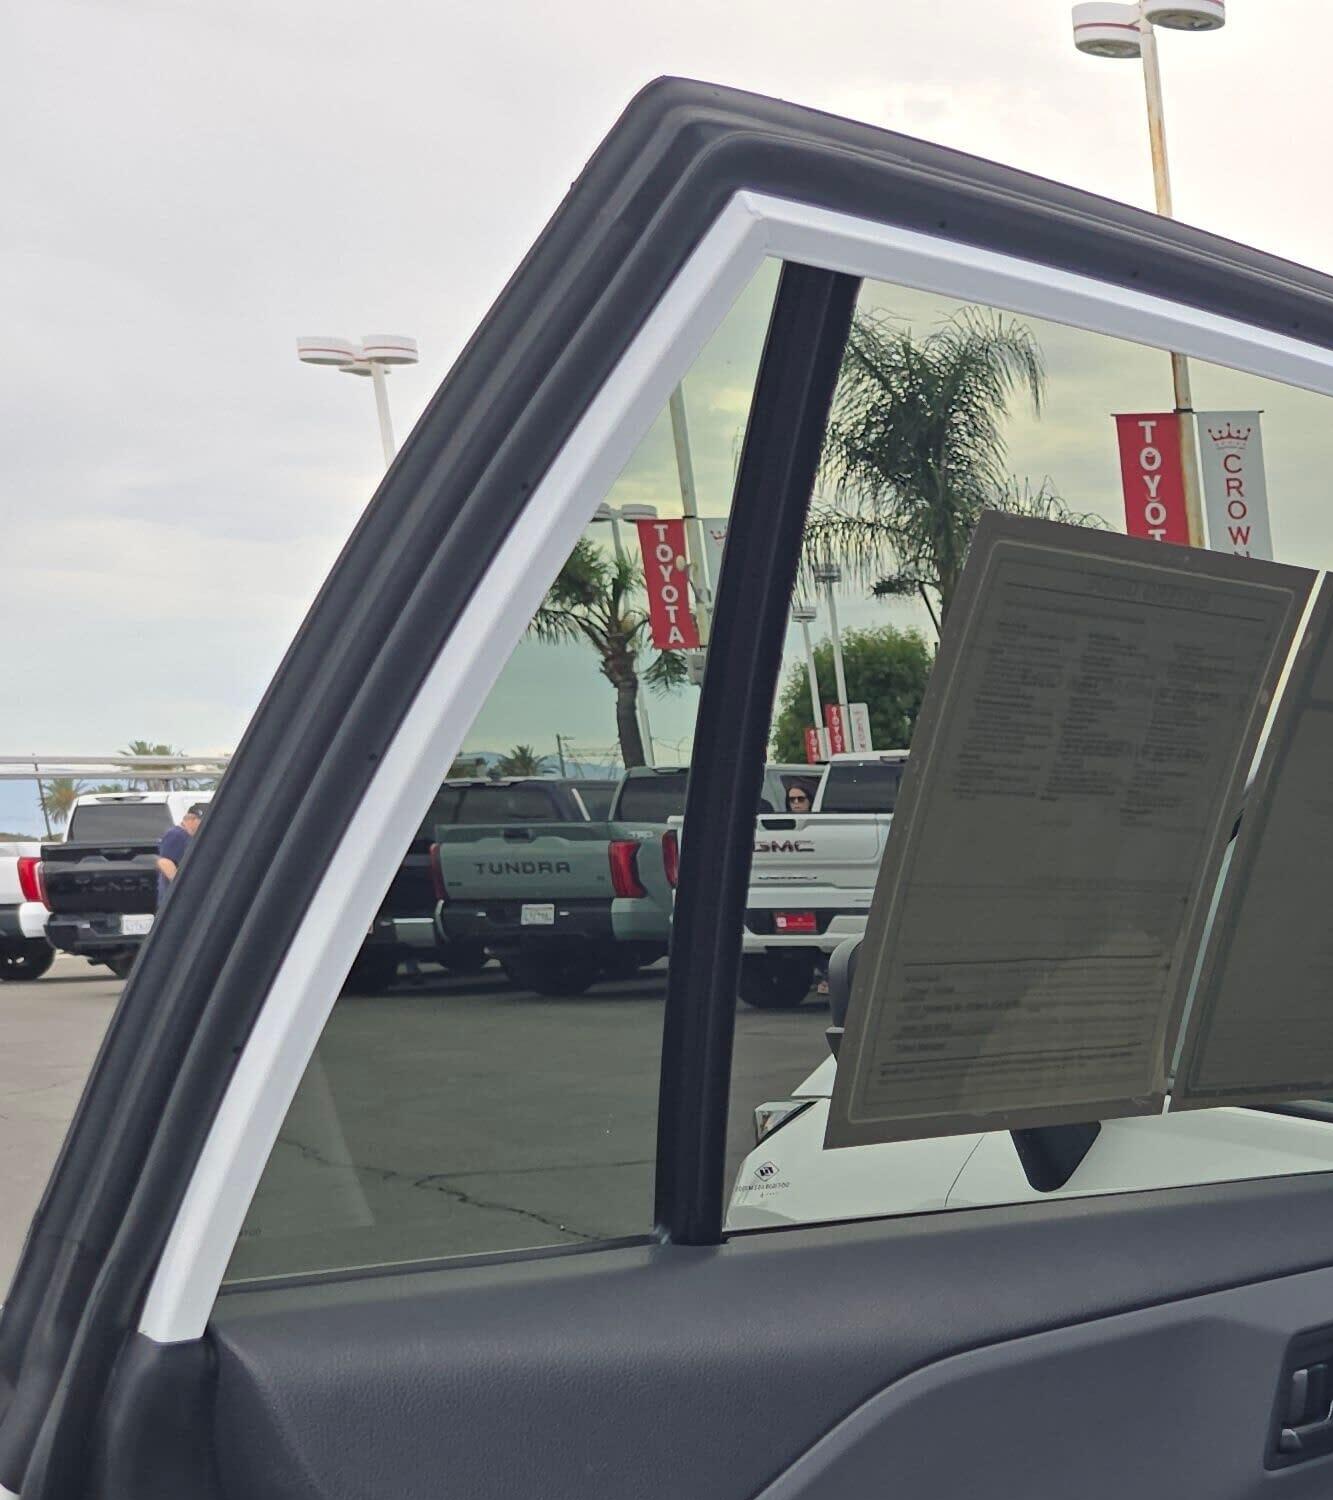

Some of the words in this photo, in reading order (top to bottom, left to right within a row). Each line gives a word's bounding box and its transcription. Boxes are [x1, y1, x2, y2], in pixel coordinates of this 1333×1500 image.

[652, 523, 685, 645] TOYOTA
[752, 840, 815, 853] GMC
[473, 861, 571, 875] TUNDRA
